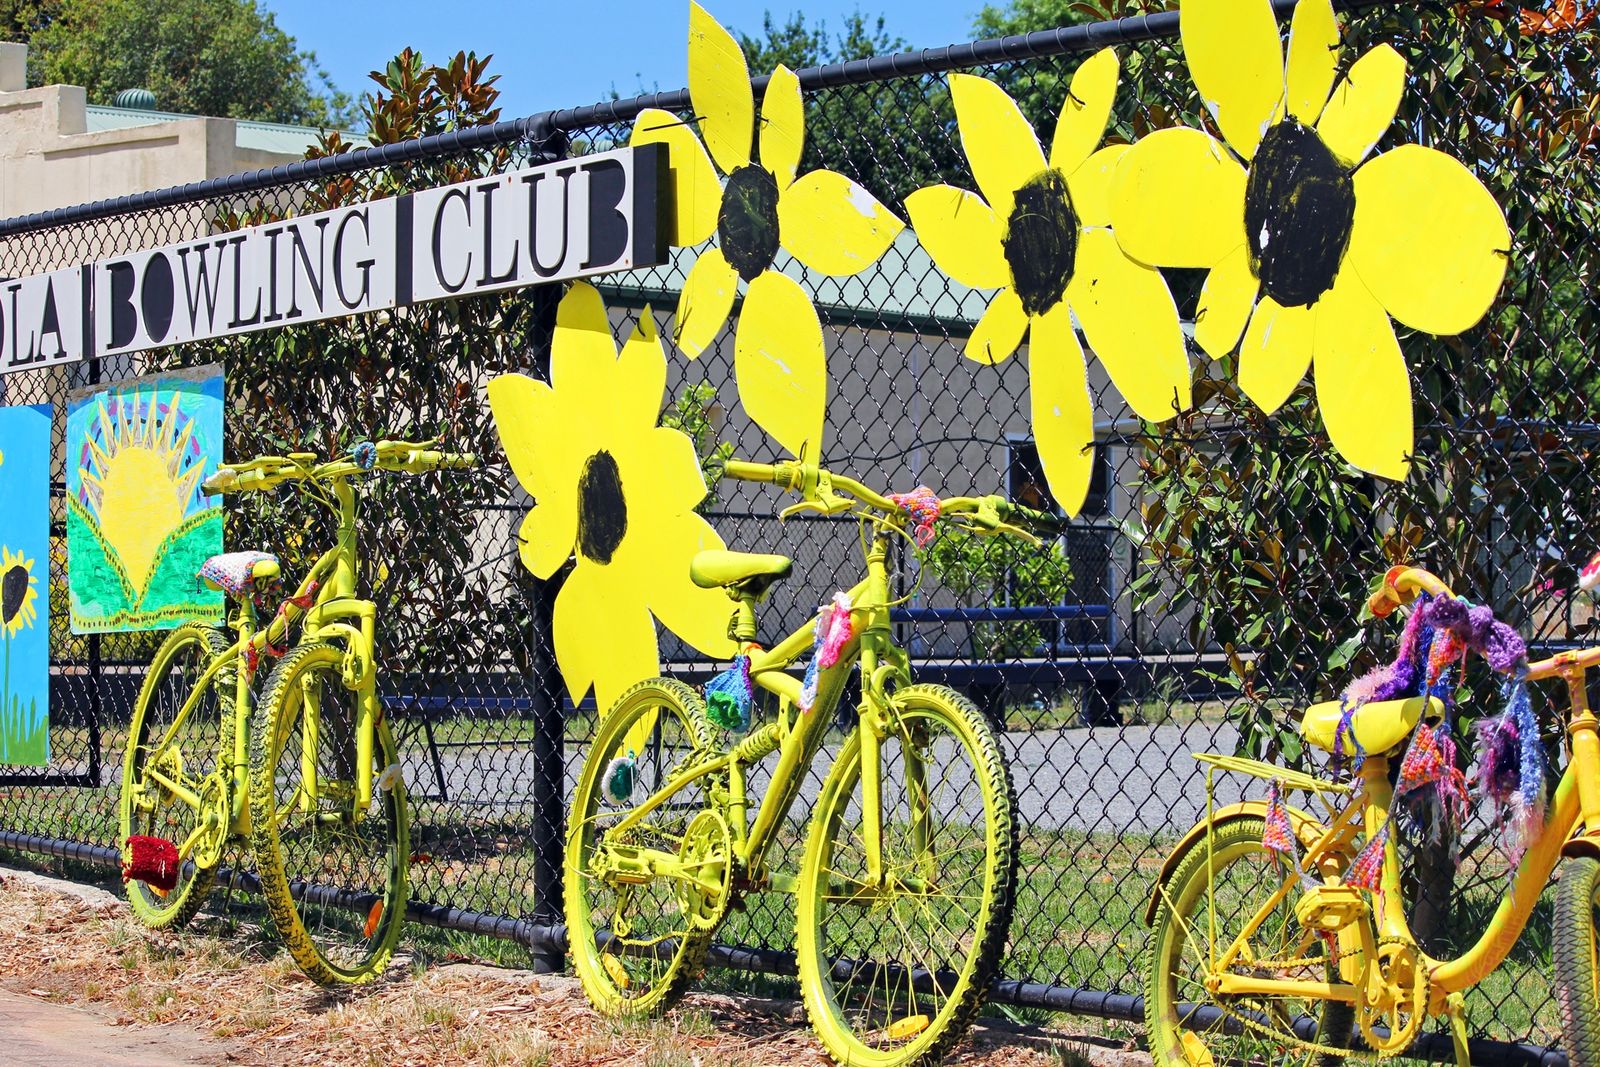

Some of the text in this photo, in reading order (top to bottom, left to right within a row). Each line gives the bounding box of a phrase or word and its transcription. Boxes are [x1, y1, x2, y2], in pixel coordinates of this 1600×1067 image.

[0, 158, 629, 367] LA BOWLING CLUB
